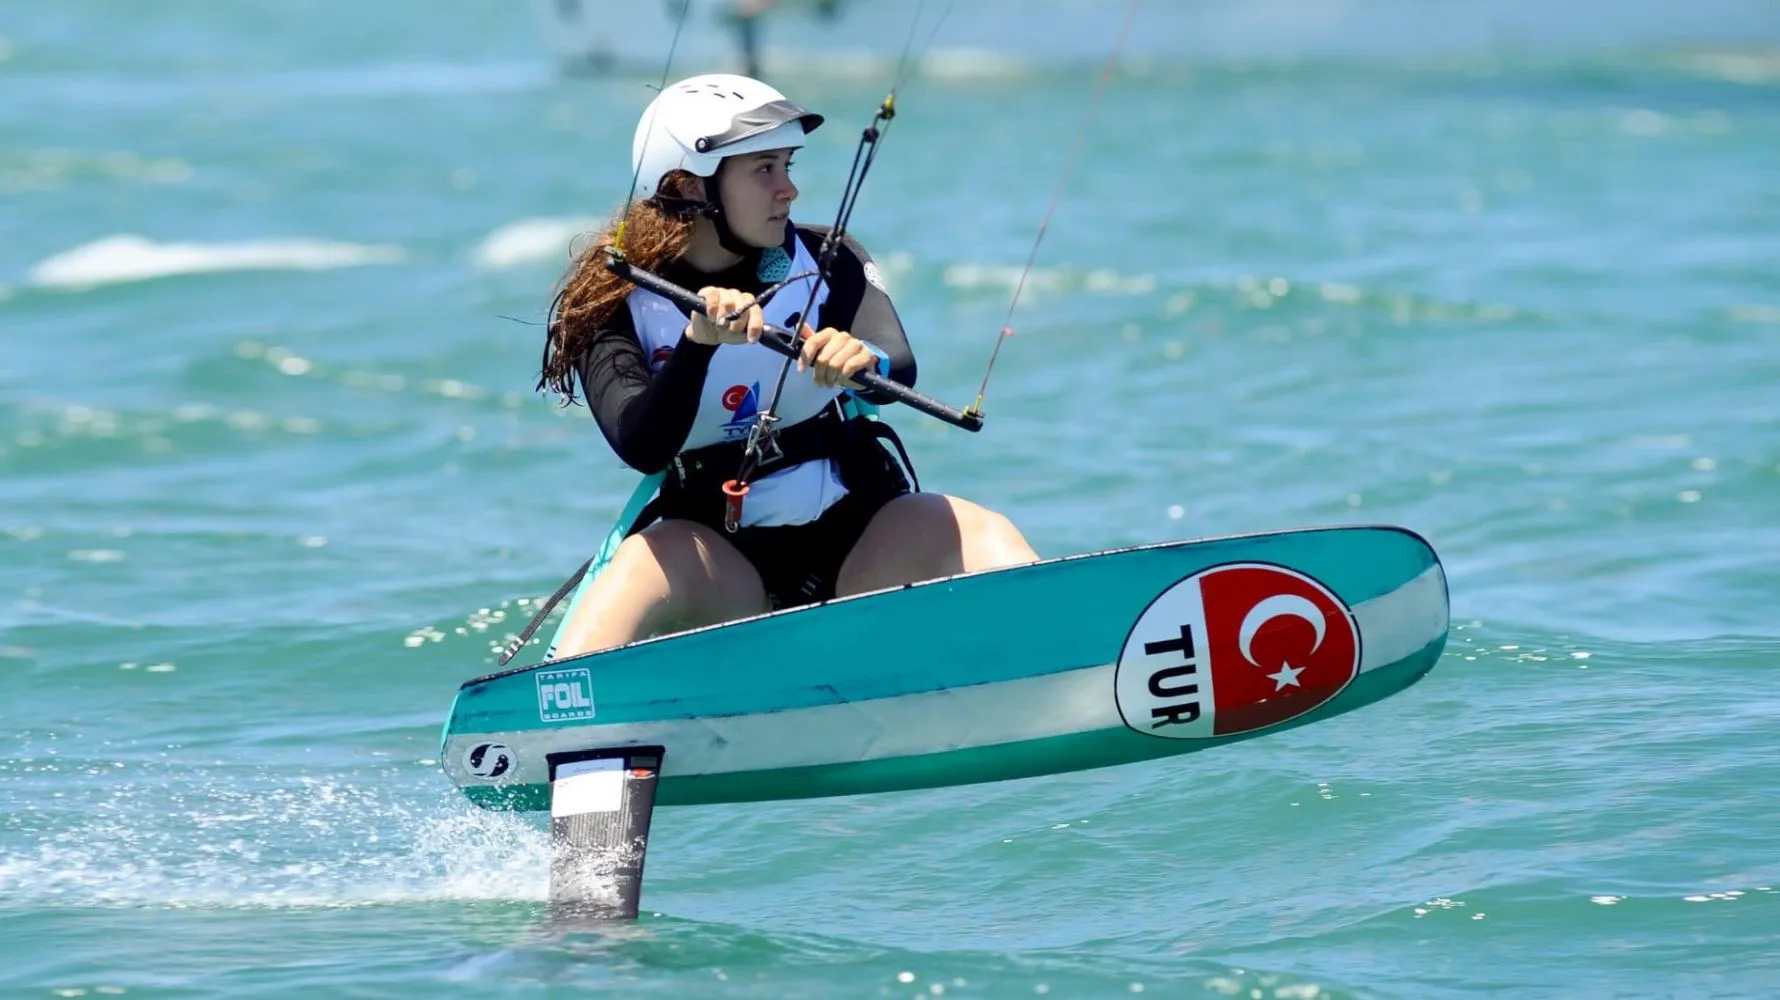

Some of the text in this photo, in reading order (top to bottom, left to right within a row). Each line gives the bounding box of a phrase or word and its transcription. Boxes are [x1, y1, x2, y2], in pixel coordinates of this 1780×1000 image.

[540, 671, 587, 681] TARIFA
[1144, 624, 1200, 729] TUR
[541, 682, 591, 710] FOIL
[543, 710, 593, 720] BOARDS
